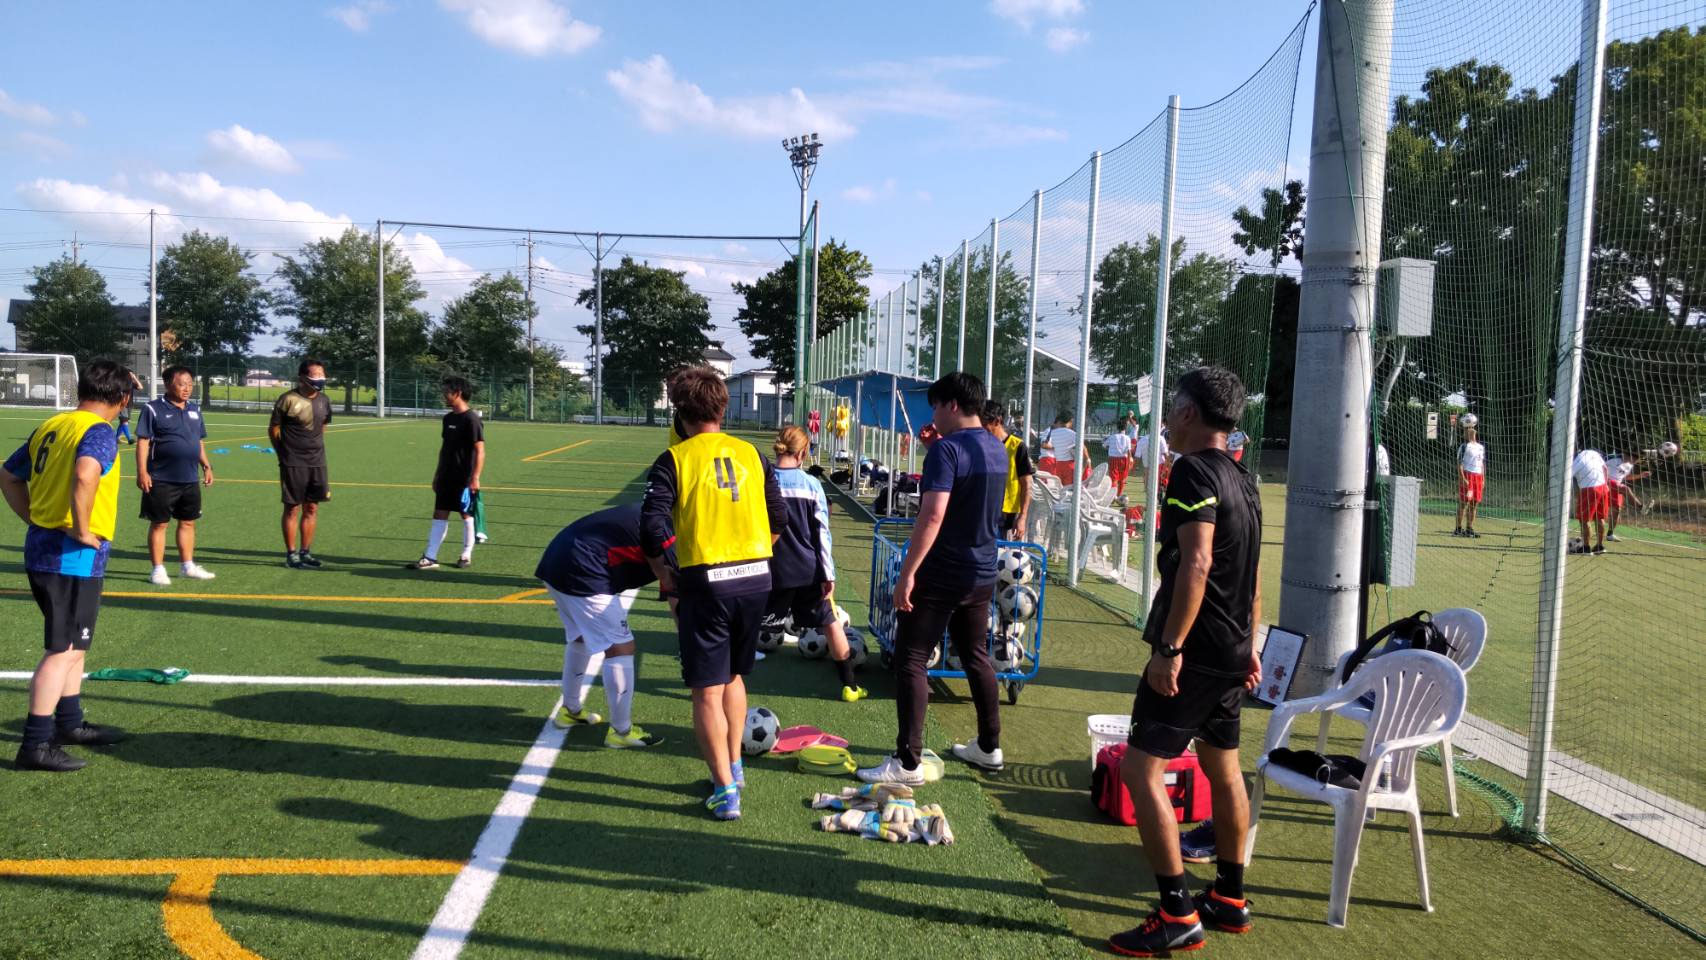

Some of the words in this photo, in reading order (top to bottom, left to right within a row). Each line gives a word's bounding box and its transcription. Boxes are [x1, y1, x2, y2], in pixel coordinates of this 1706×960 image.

[34, 430, 57, 474] 6
[713, 457, 740, 502] 4
[713, 570, 724, 580] BE
